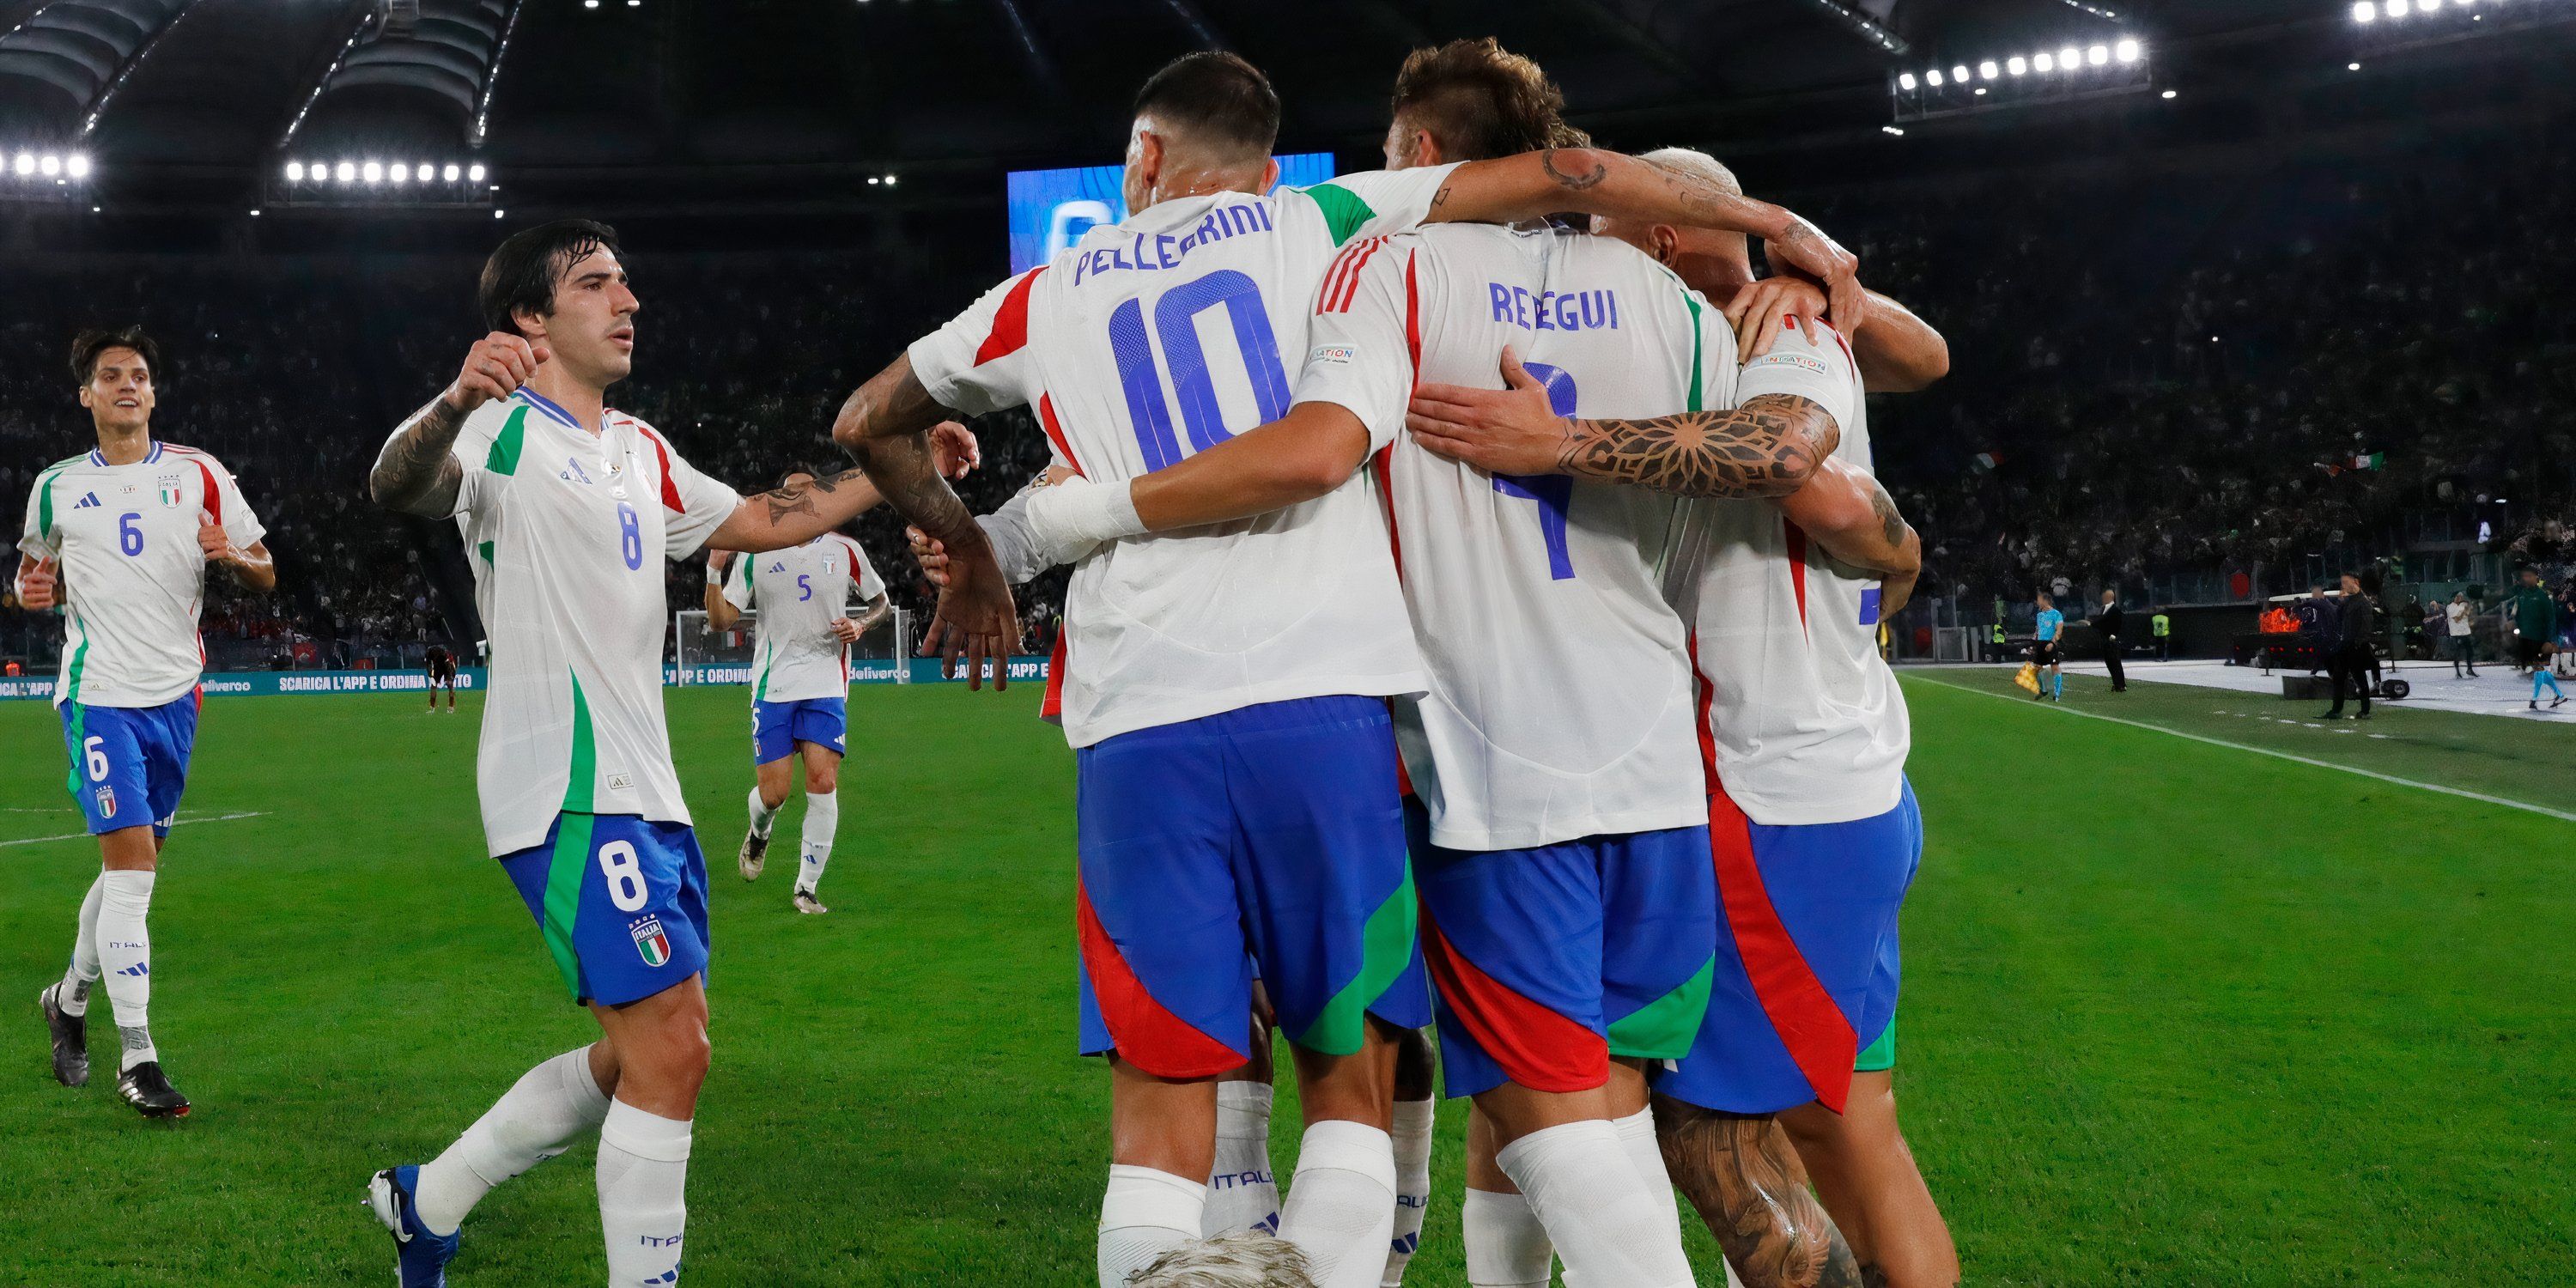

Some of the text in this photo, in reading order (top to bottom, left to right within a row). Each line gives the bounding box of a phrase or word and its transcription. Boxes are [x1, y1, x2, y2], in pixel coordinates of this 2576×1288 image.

[1109, 270, 1291, 474] 10
[119, 513, 143, 556] 6
[617, 501, 642, 570] 8
[798, 574, 812, 602] 5
[279, 677, 331, 691] SCARICA
[333, 676, 367, 690] L'APP
[370, 676, 377, 690] E
[696, 670, 704, 683] E
[84, 736, 108, 782] 6
[598, 840, 648, 912] 8
[635, 923, 659, 940] ITALIA
